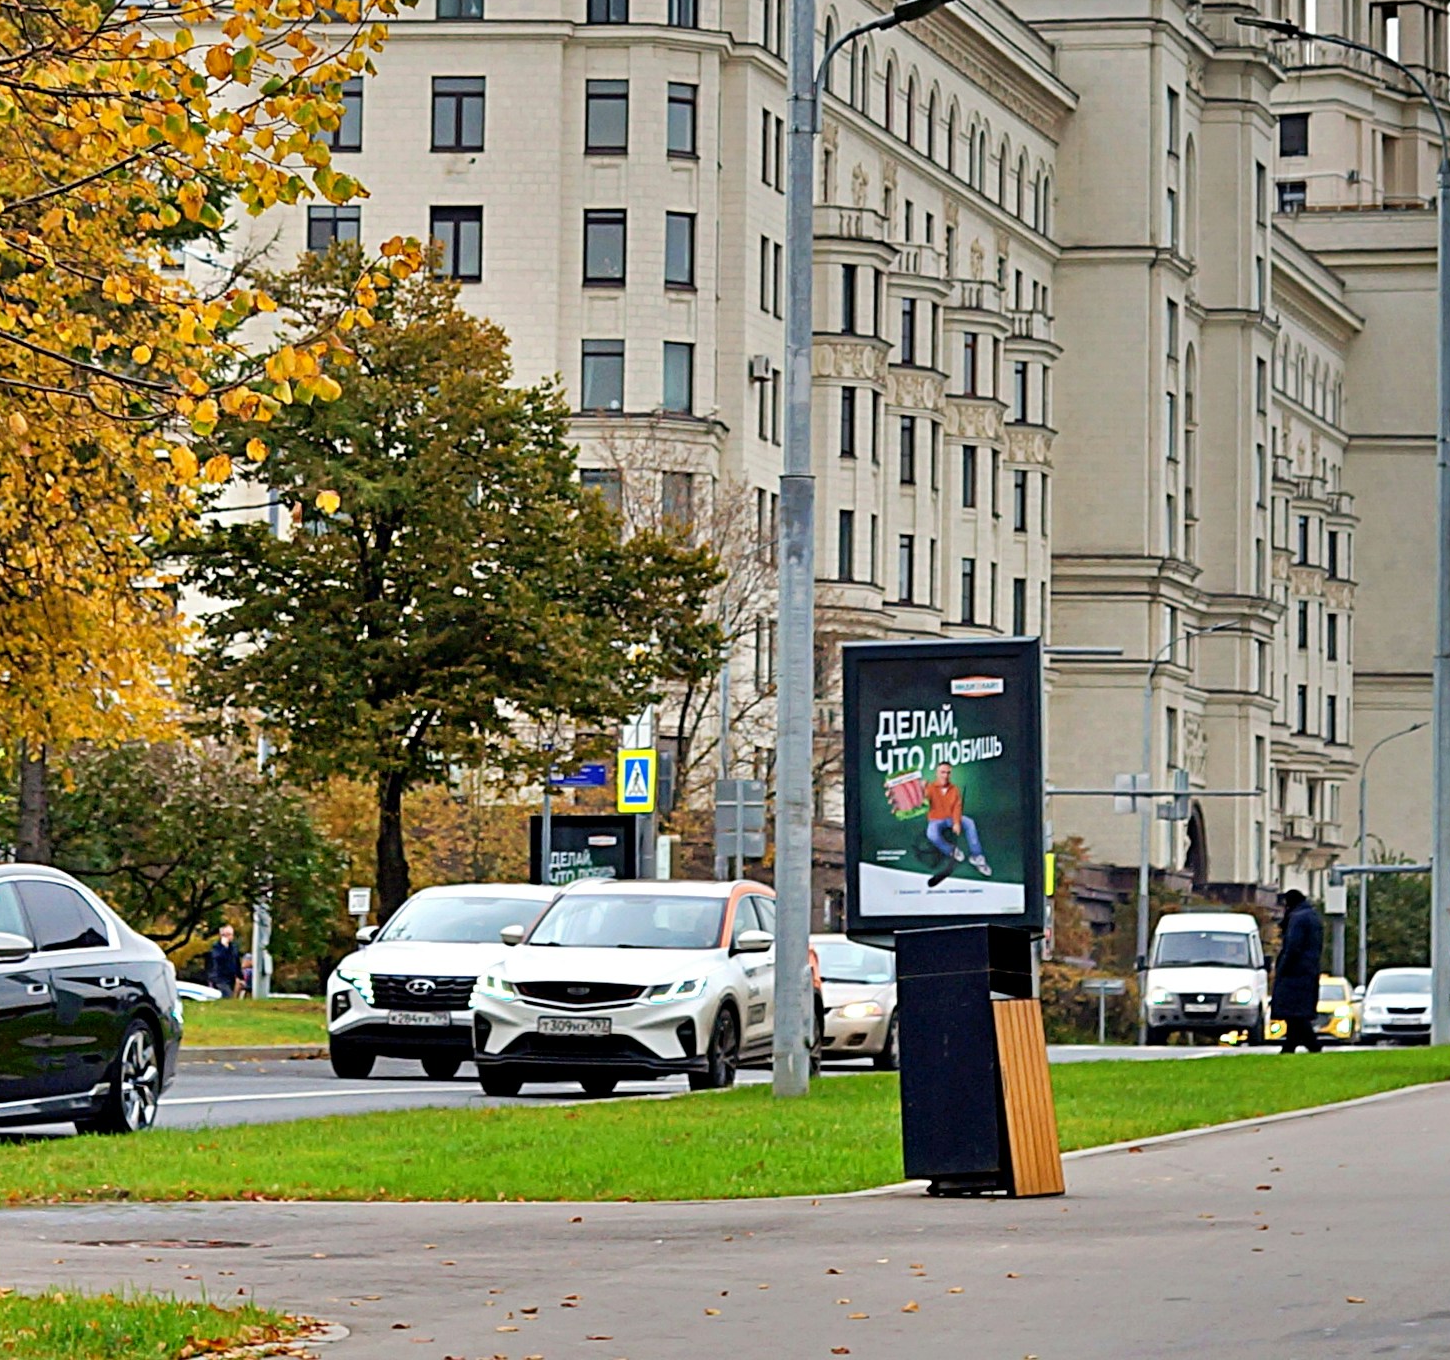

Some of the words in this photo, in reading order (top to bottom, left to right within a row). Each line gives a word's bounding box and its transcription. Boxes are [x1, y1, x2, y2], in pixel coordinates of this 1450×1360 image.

[875, 704, 958, 748] ДЕЛАЙ,
[875, 745, 925, 775] ЧТО
[929, 735, 1003, 771] ЛЮБИШЬ
